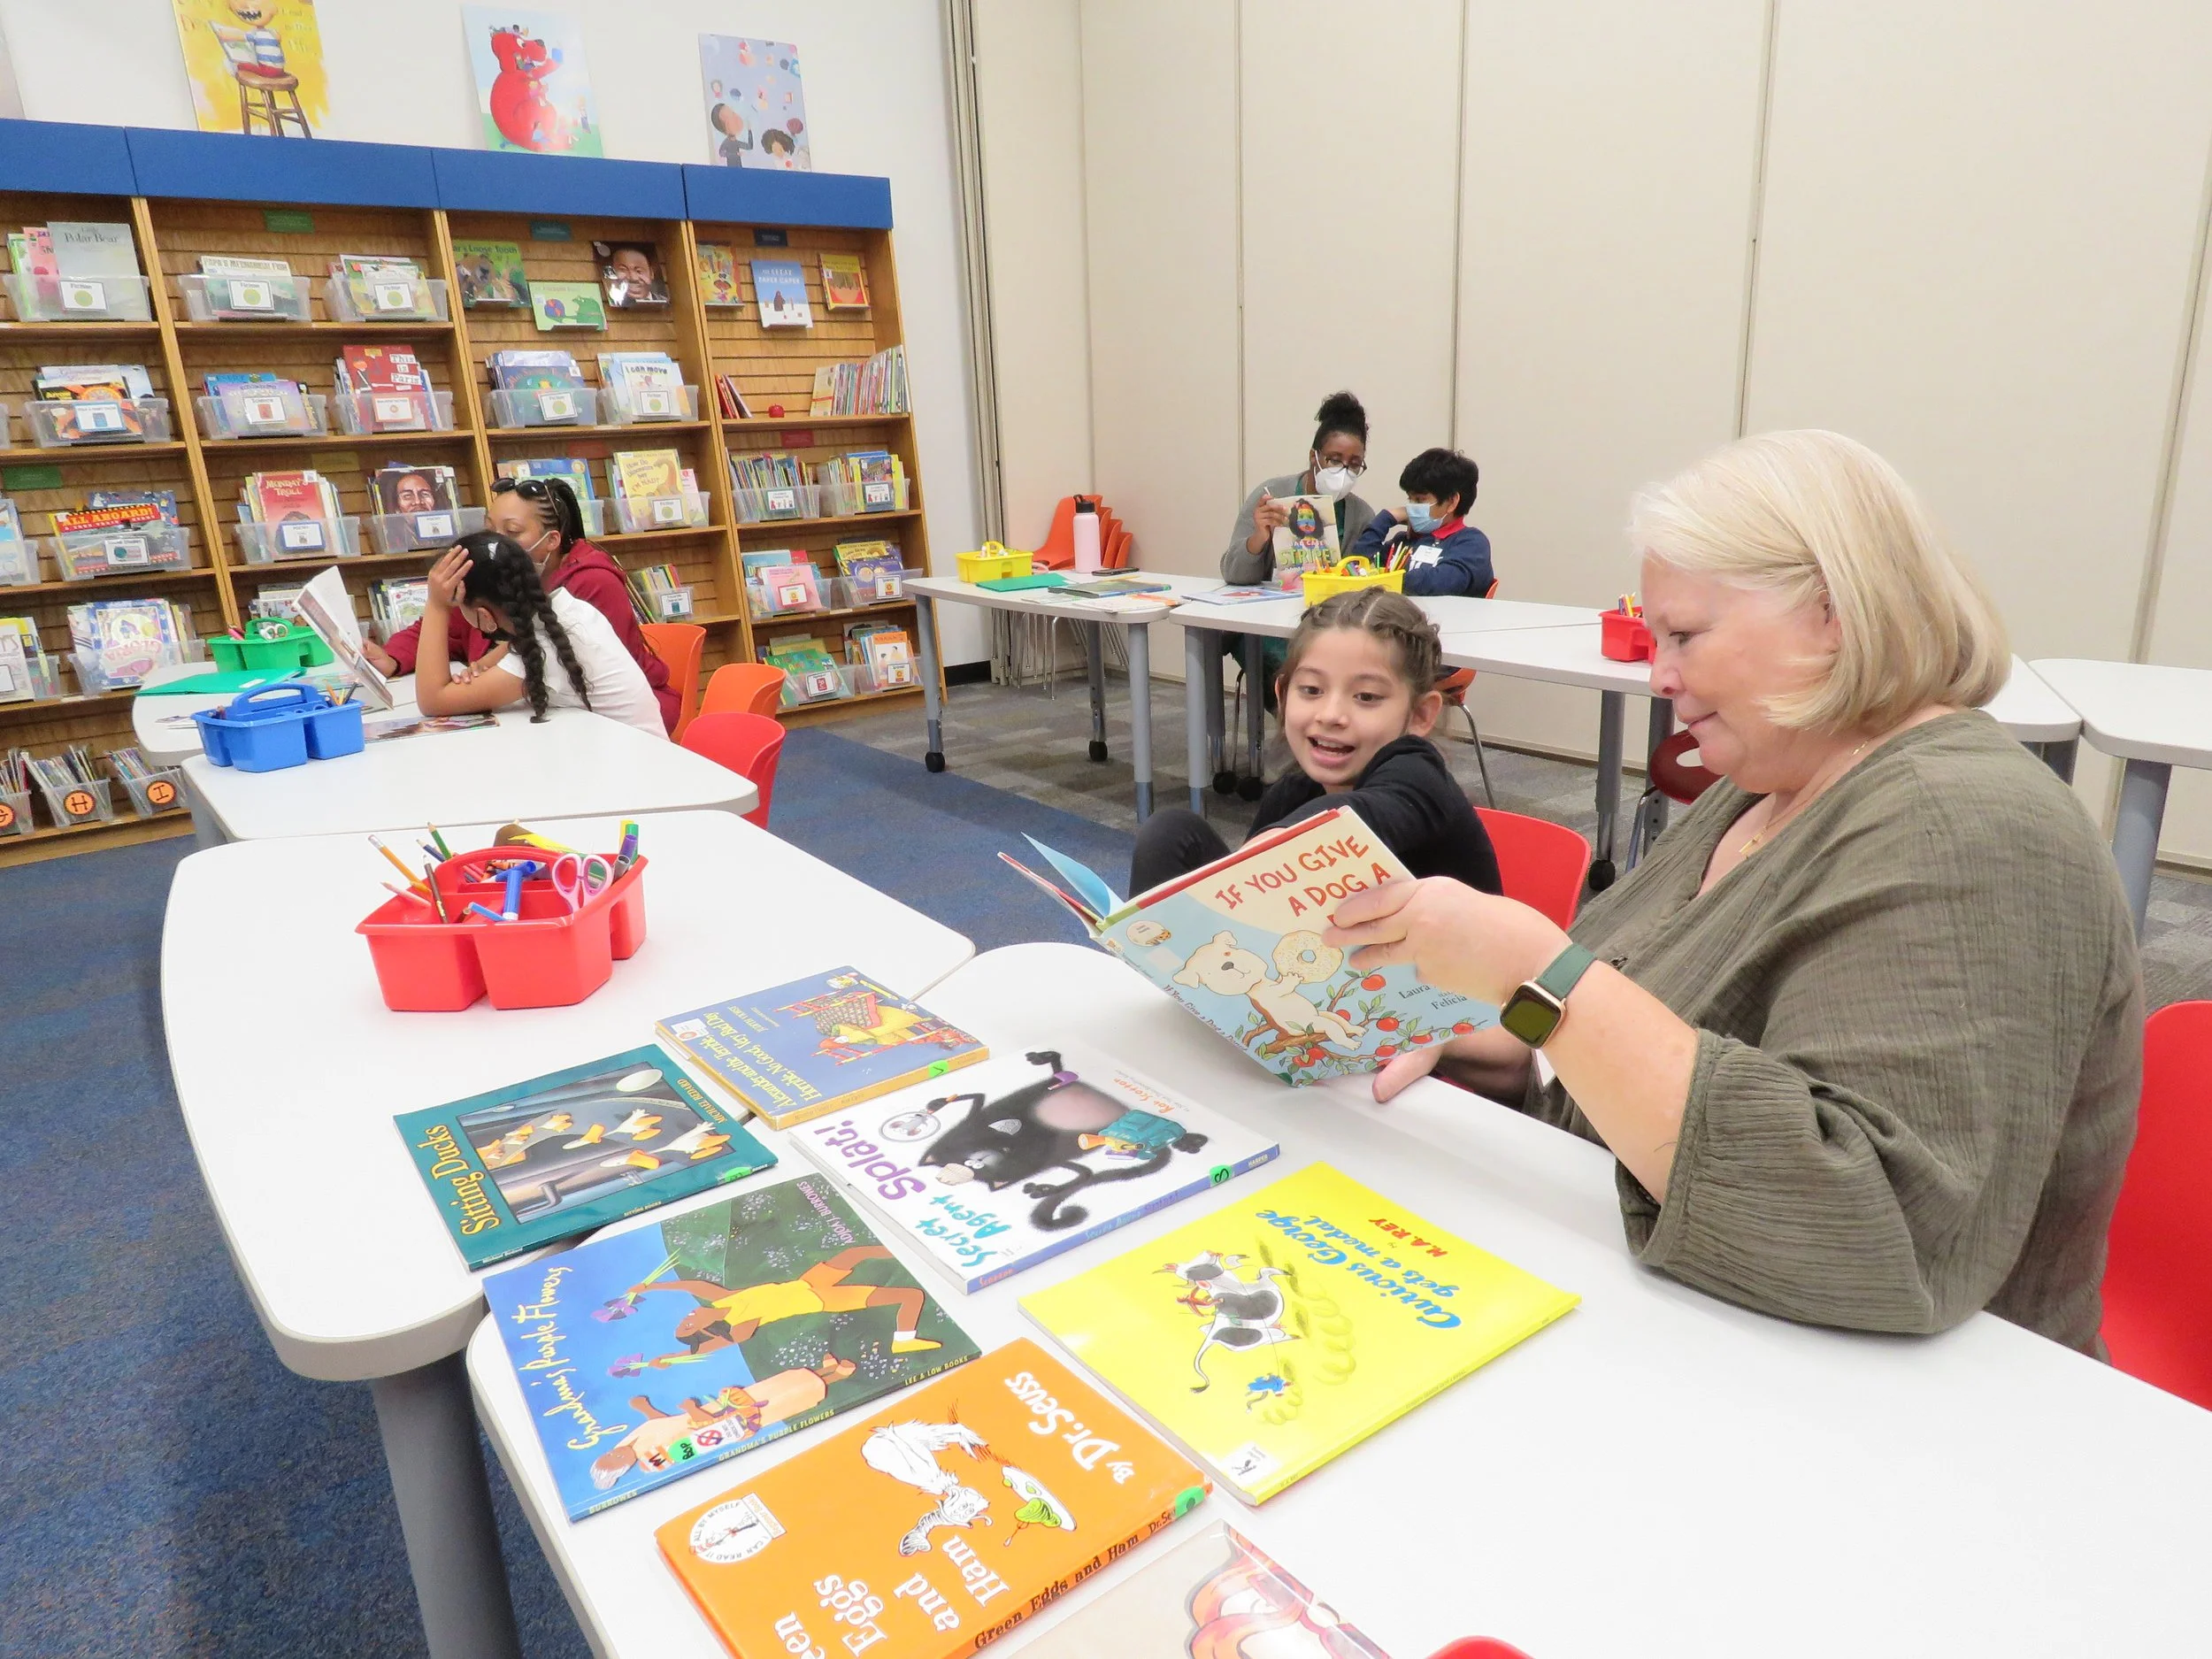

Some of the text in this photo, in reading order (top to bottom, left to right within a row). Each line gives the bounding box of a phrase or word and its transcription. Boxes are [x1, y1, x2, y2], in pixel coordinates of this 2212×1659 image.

[65, 233, 119, 243] Polar Bear
[468, 245, 493, 255] Loose
[495, 245, 518, 255] Tooth
[391, 373, 419, 384] Paris
[647, 366, 668, 376] move
[265, 477, 309, 489] MONDAY'S
[276, 487, 303, 497] TROLL
[63, 506, 154, 526] ALL ABOARD!
[1279, 549, 1339, 565] STRIPES
[153, 784, 171, 801] I
[72, 798, 88, 812] H
[1215, 835, 1370, 910] IF YOU GIVE
[1287, 862, 1392, 918] A DOG A
[1164, 984, 1174, 993] If
[1171, 990, 1185, 1003] You
[1185, 1002, 1201, 1017] Give
[1398, 984, 1432, 999] Laura
[1431, 994, 1468, 1010] Felicia
[703, 1012, 724, 1029] Day
[720, 1024, 739, 1037] Bad
[733, 1033, 753, 1049] Very
[726, 1056, 741, 1071] the
[740, 1064, 759, 1081] and
[766, 1063, 788, 1075] No
[753, 1075, 797, 1107] Alexander
[1113, 1077, 1153, 1102] Scotton
[677, 1079, 728, 1124] MICHAEL BEDARD
[1154, 1100, 1176, 1114] Rob
[813, 1119, 926, 1201] Splat!
[1248, 1153, 1269, 1168] HARPER
[416, 1124, 502, 1236] Sitting Ducks
[1213, 1167, 1230, 1184] S
[796, 1180, 833, 1217] BURROWES
[928, 1194, 1013, 1239] Agent
[831, 1218, 856, 1245] ADJOA
[1368, 1217, 1412, 1240] REY
[915, 1217, 998, 1267] Secret
[1303, 1215, 1460, 1297] gets a medal
[1256, 1210, 1462, 1328] Curious George
[511, 1266, 629, 1450] Grandma's Purple Flowers
[904, 1376, 917, 1386] LEE
[926, 1365, 942, 1377] LOW
[944, 1355, 969, 1371] BOOKS
[1003, 1371, 1135, 1486] By Dr. Seuss
[588, 1490, 638, 1515] BURROWES
[718, 1435, 766, 1463] GRANDMA'S
[767, 1425, 798, 1442] PURPLE
[799, 1409, 836, 1429] FLOWERS
[648, 1452, 666, 1467] M
[707, 1501, 741, 1518] MYSELF
[716, 1552, 742, 1561] READ
[747, 1540, 764, 1555] CAN
[941, 1534, 1011, 1608] Ham
[974, 1609, 1023, 1650] Green
[1029, 1579, 1069, 1615] Eggs
[1075, 1555, 1102, 1584] and
[1106, 1532, 1140, 1563] Ham
[1148, 1519, 1164, 1534] Dr.
[893, 1571, 961, 1632] and
[813, 1574, 888, 1658] Eggs
